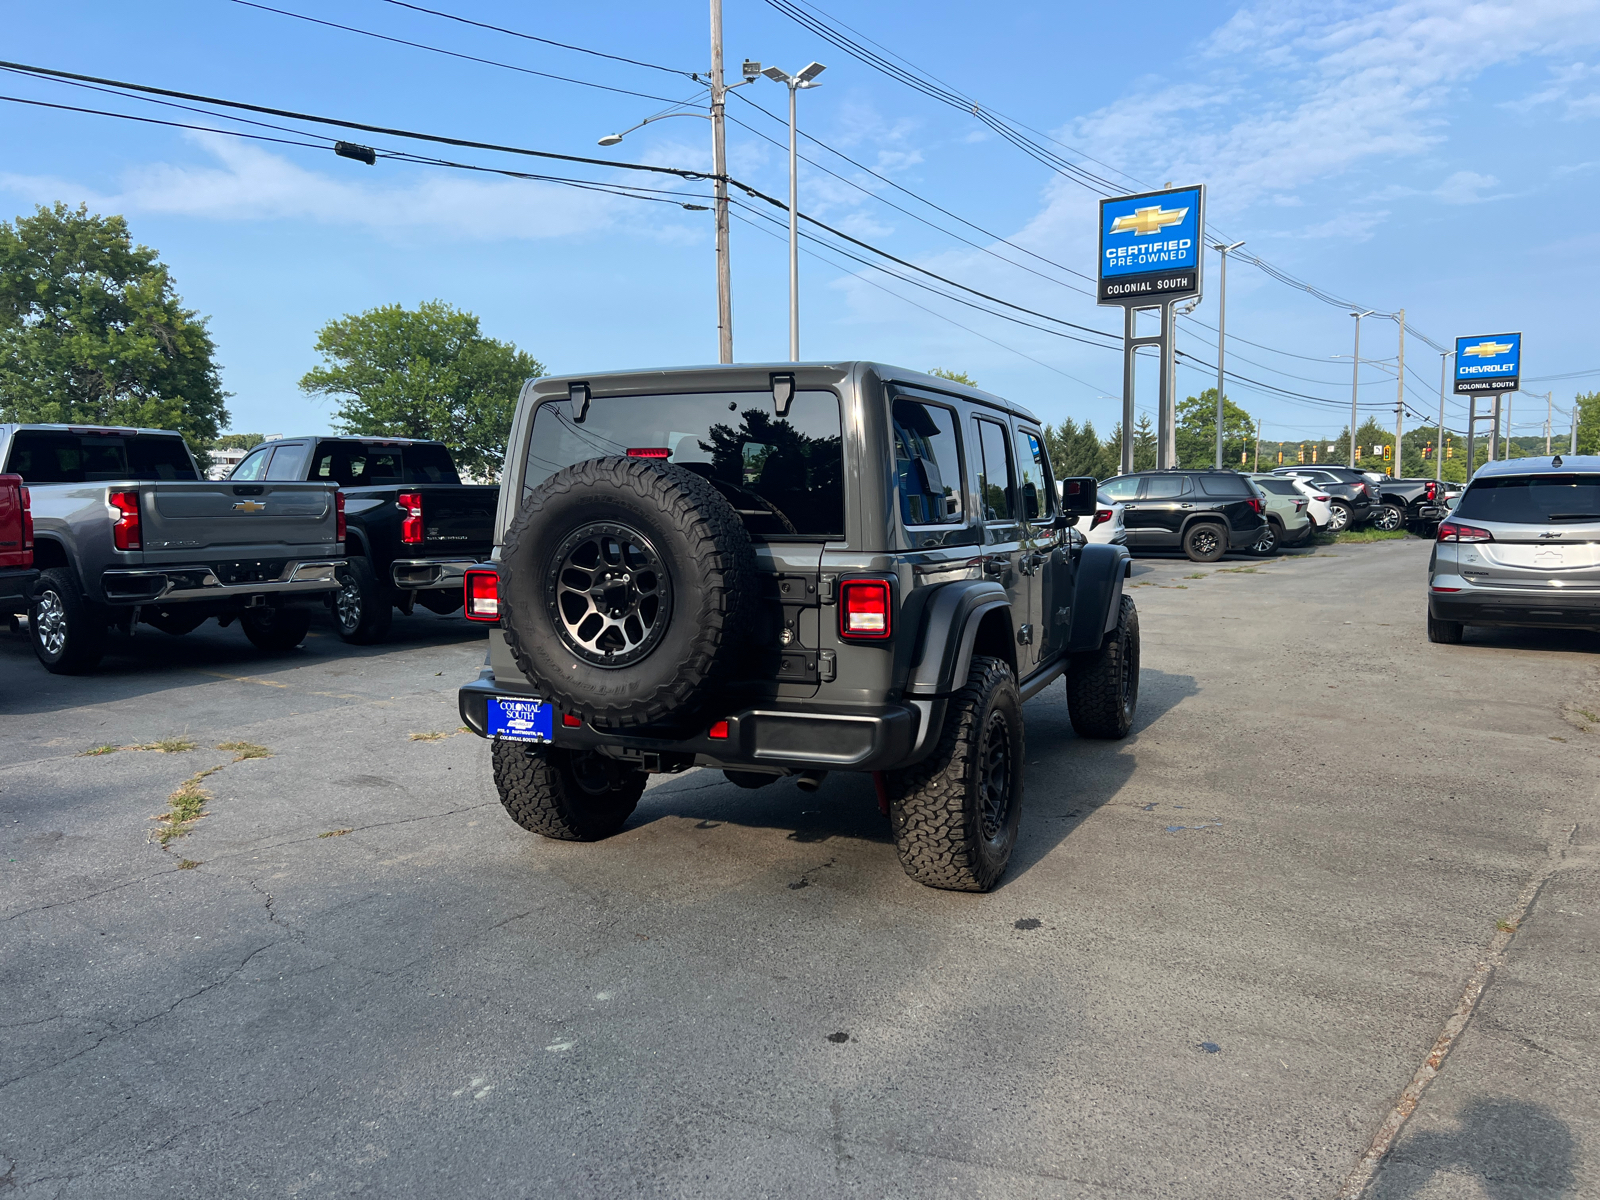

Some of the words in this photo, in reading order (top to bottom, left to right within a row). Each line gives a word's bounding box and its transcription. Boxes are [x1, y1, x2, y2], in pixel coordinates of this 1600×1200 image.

[1106, 239, 1191, 258] CERTIFIED
[1109, 250, 1186, 267] PRE-OWNED
[1107, 282, 1152, 294] COLONIAL
[1157, 278, 1188, 289] SOUTH
[1460, 363, 1515, 374] CHEVROLET
[500, 701, 541, 713] COLONIAL
[506, 710, 534, 720] SOUTH
